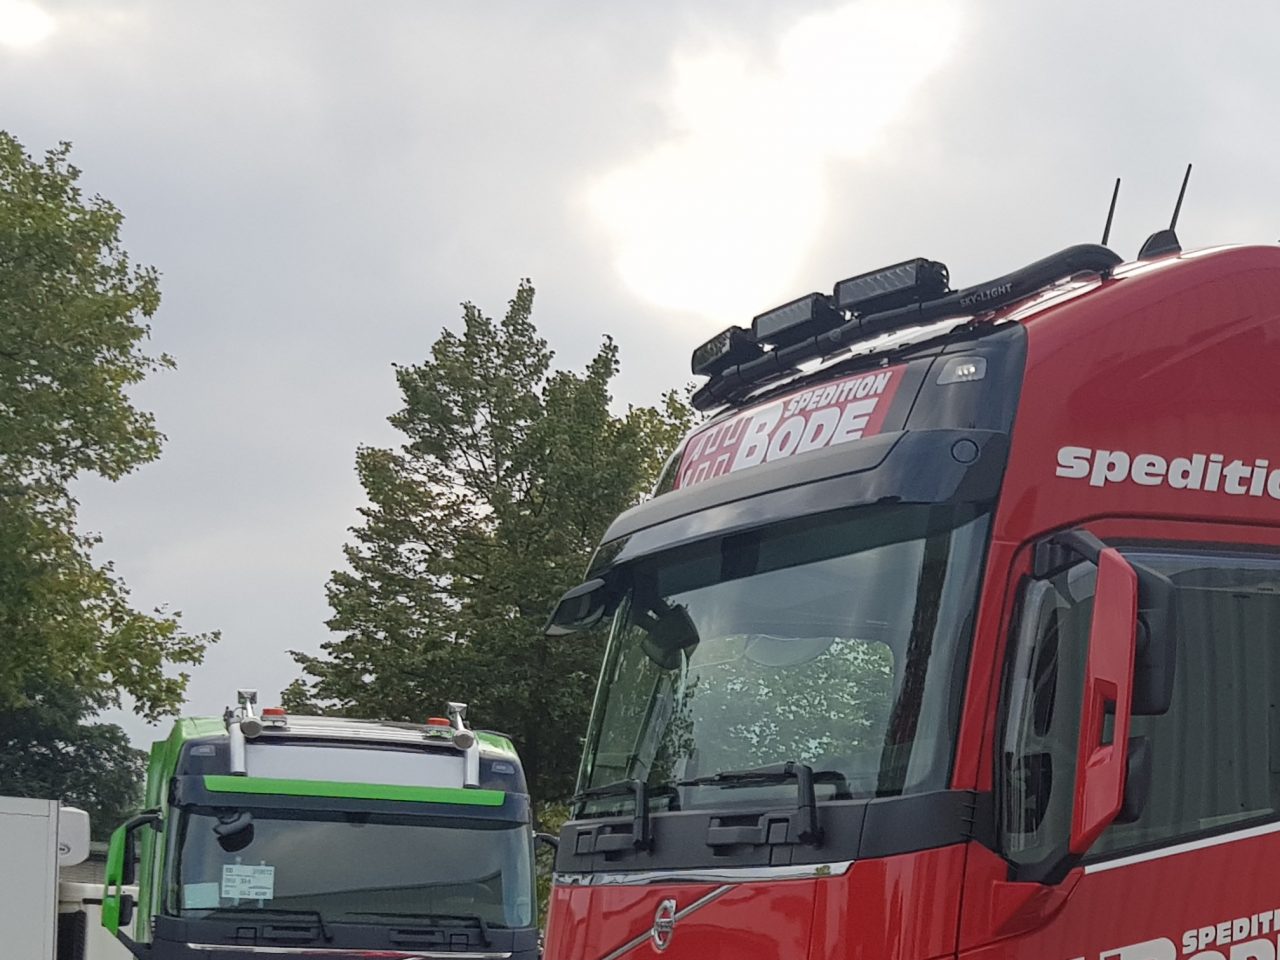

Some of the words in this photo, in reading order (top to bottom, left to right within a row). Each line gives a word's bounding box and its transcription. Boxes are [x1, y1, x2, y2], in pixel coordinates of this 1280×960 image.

[959, 282, 1012, 306] SKY-LIGHT
[783, 371, 893, 419] SPEDITION
[731, 398, 880, 472] BODE
